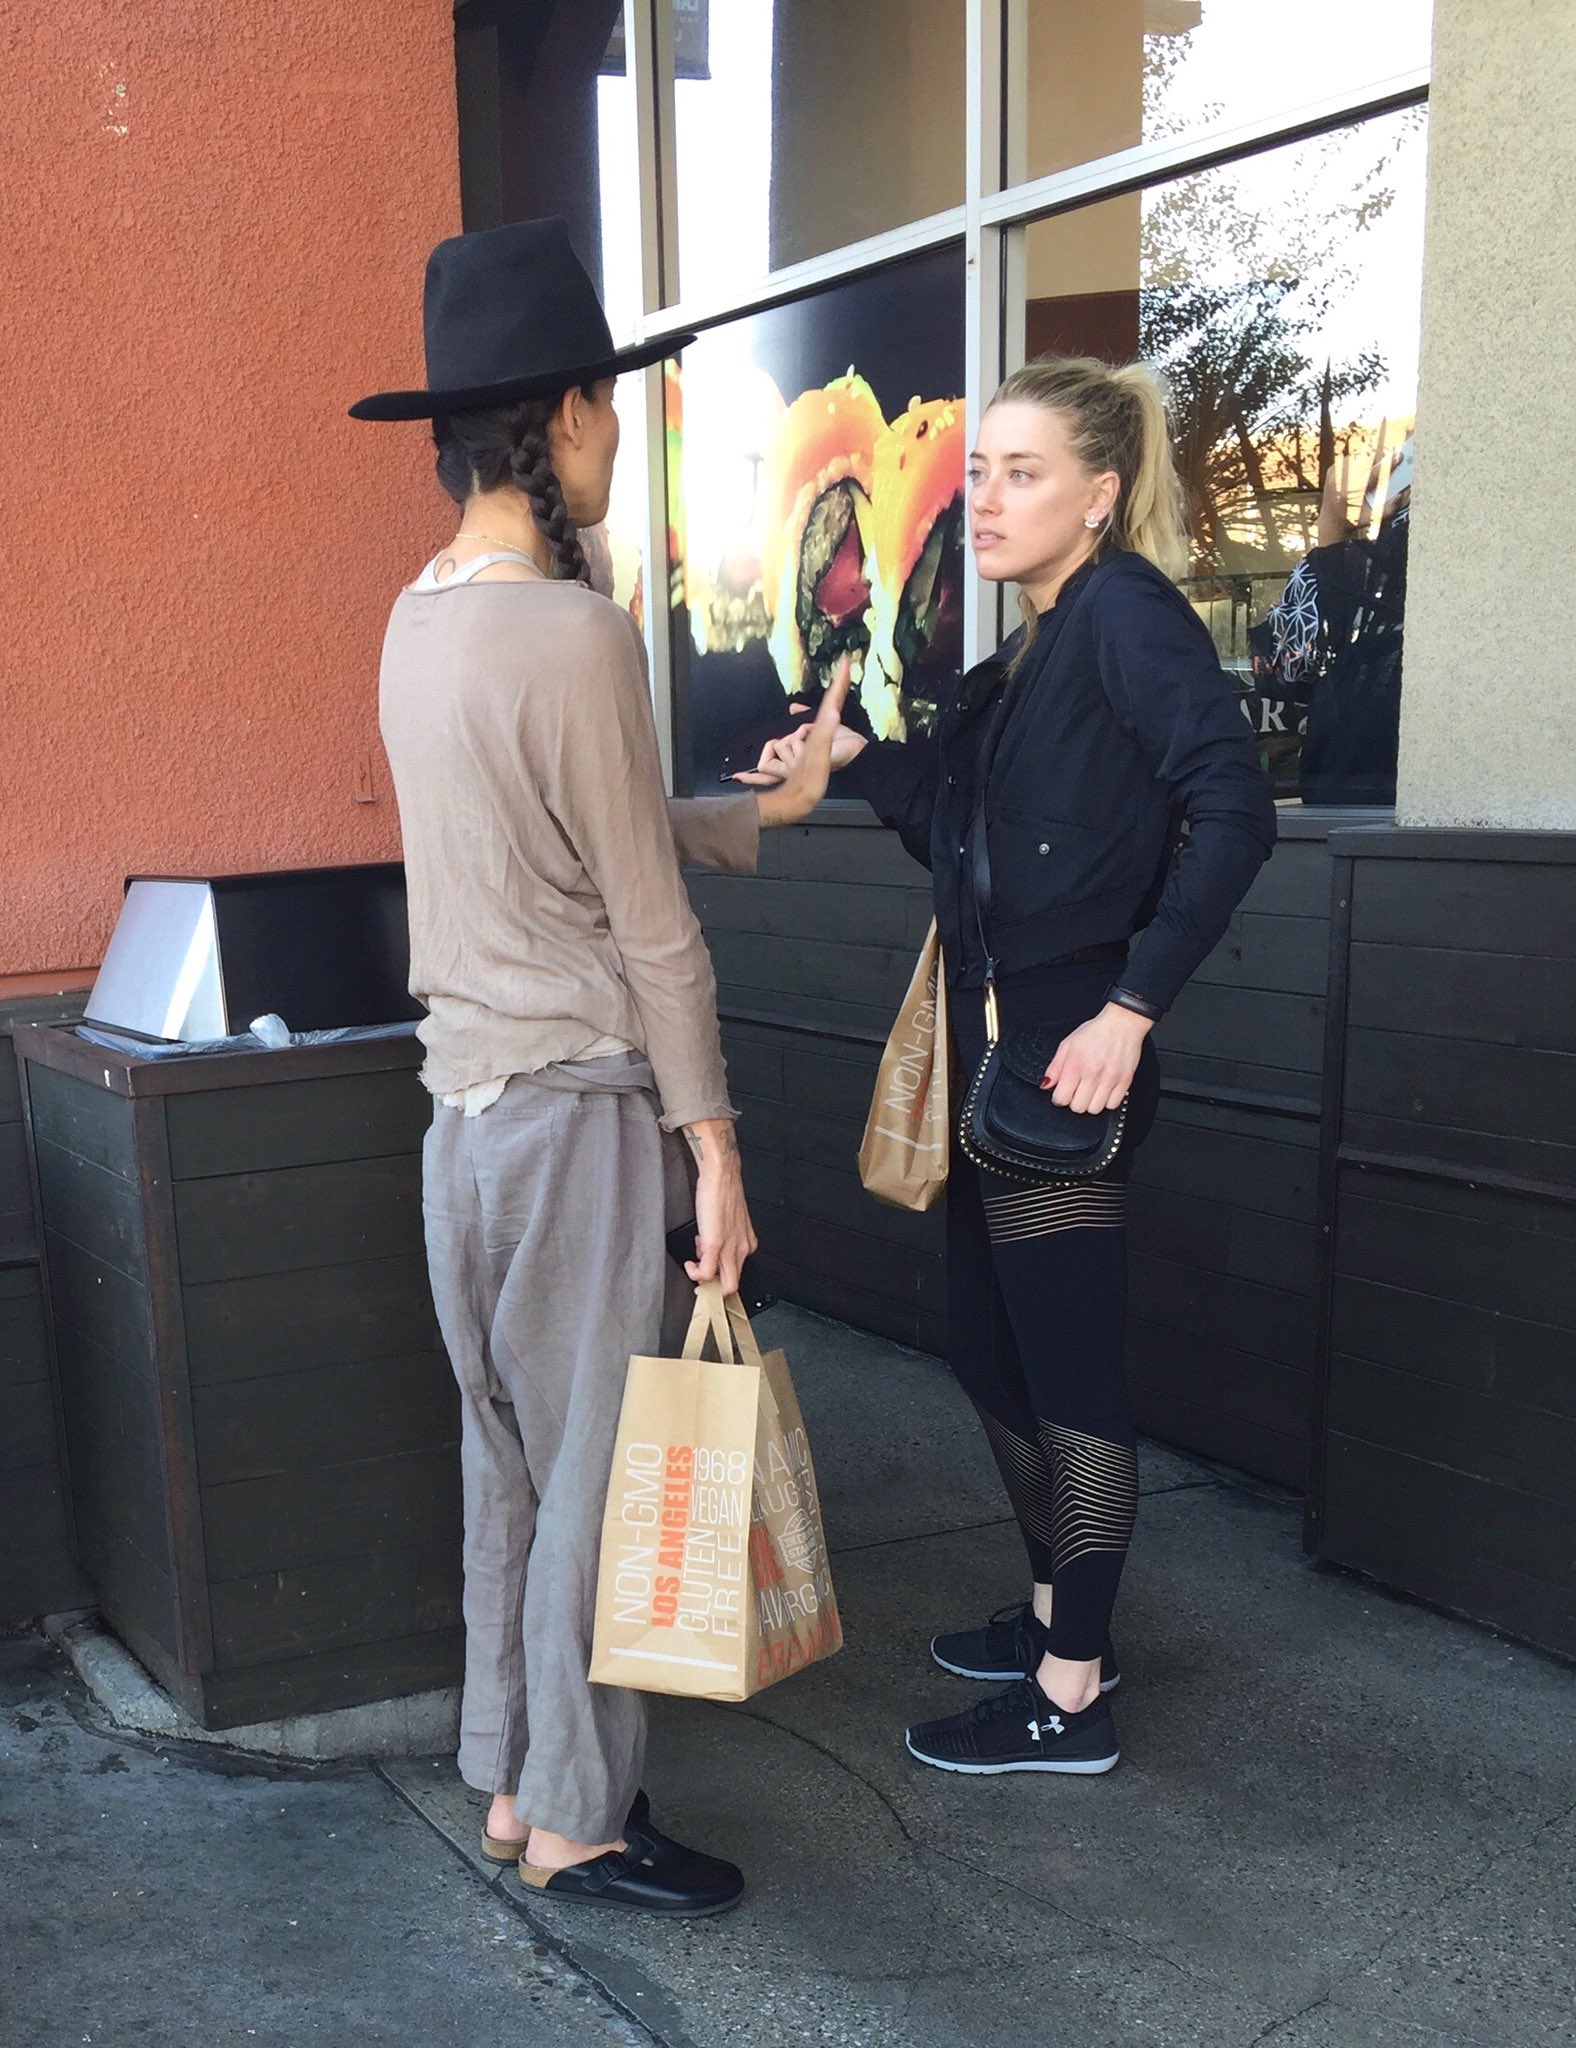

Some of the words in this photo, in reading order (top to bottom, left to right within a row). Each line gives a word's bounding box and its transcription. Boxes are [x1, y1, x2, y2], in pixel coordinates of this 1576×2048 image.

[658, 1445, 693, 1571] ANGELES
[690, 1485, 745, 1528] VEGAN
[692, 1447, 747, 1486] 1968
[612, 1441, 663, 1626] NON-GMO
[676, 1526, 716, 1633] GLUTEN
[711, 1531, 743, 1637] FREE
[651, 1575, 681, 1629] LOS
